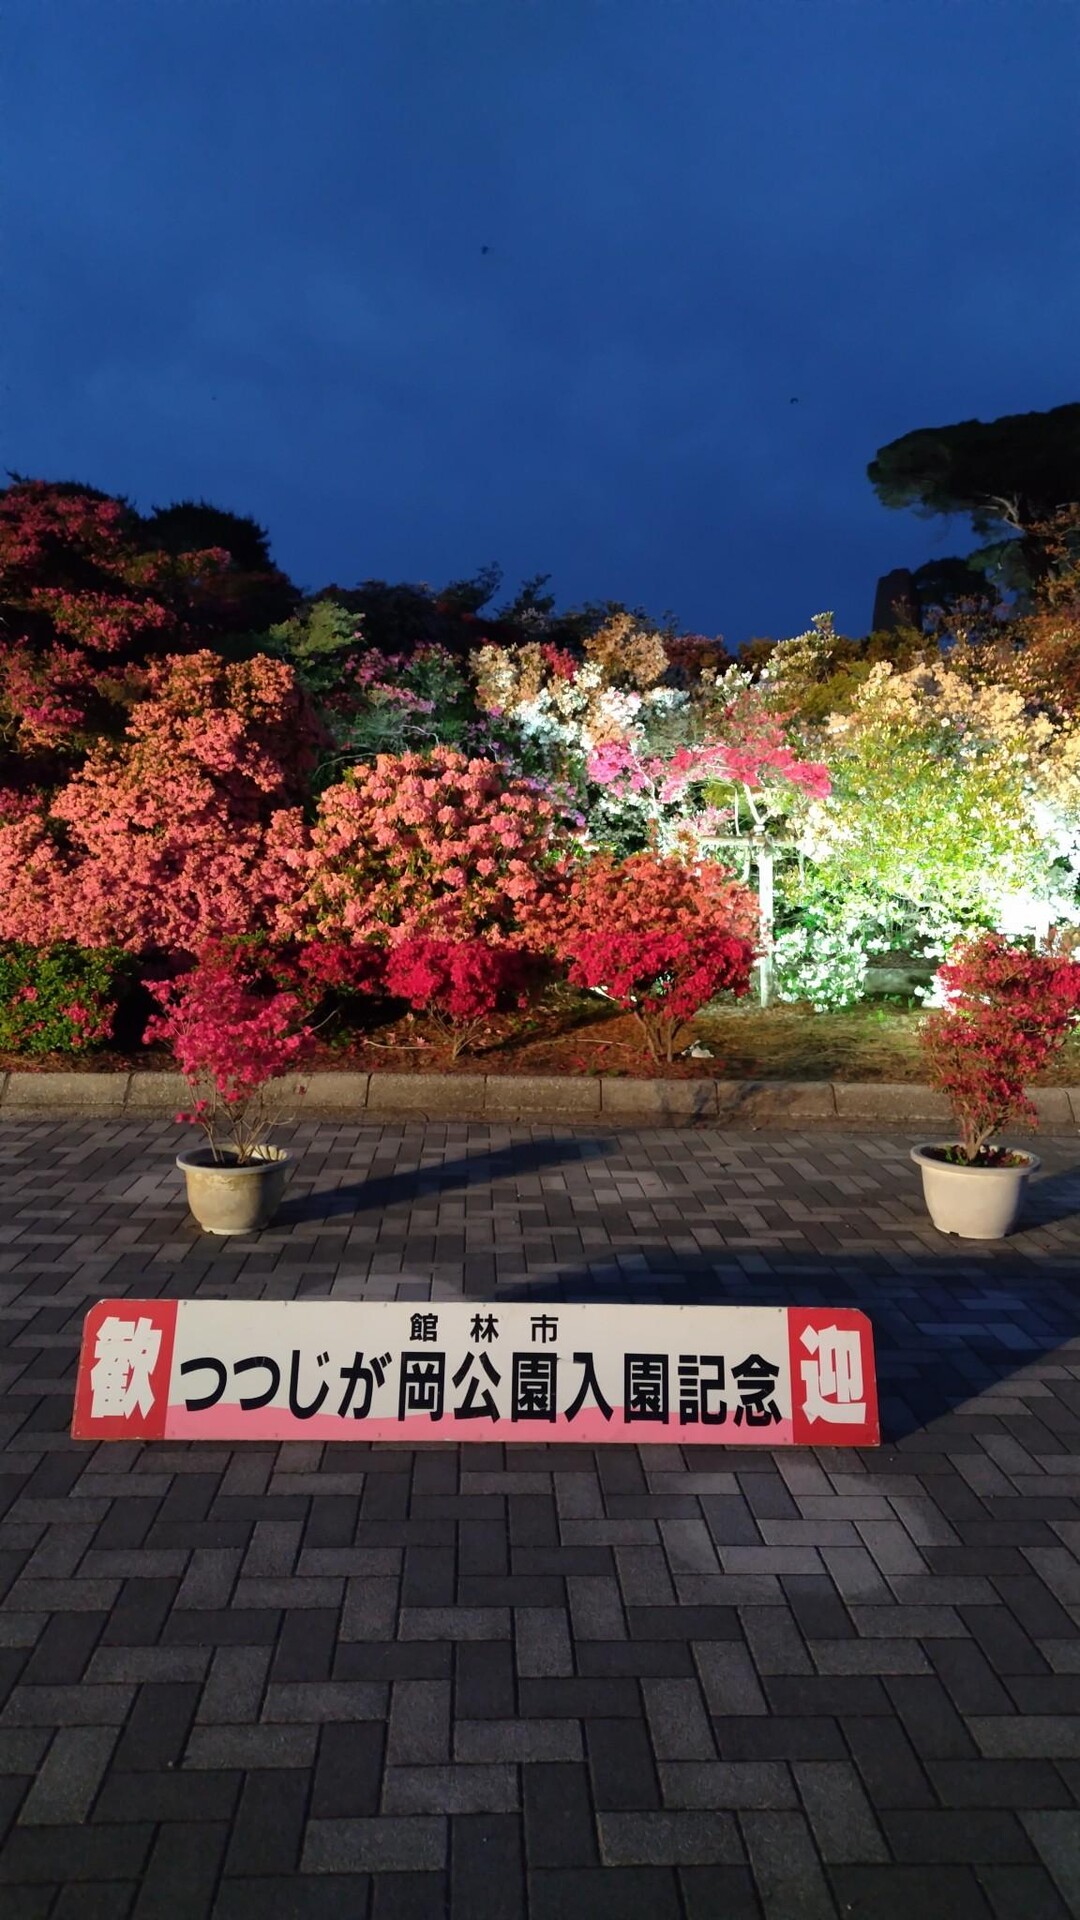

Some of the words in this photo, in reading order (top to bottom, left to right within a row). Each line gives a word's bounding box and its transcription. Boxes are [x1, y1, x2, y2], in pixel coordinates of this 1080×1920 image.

[90, 1316, 162, 1420] 歓
[410, 1313, 559, 1343] 館林市
[180, 1349, 783, 1427] つつじが岡公園入園記念
[799, 1324, 866, 1425] 迎
